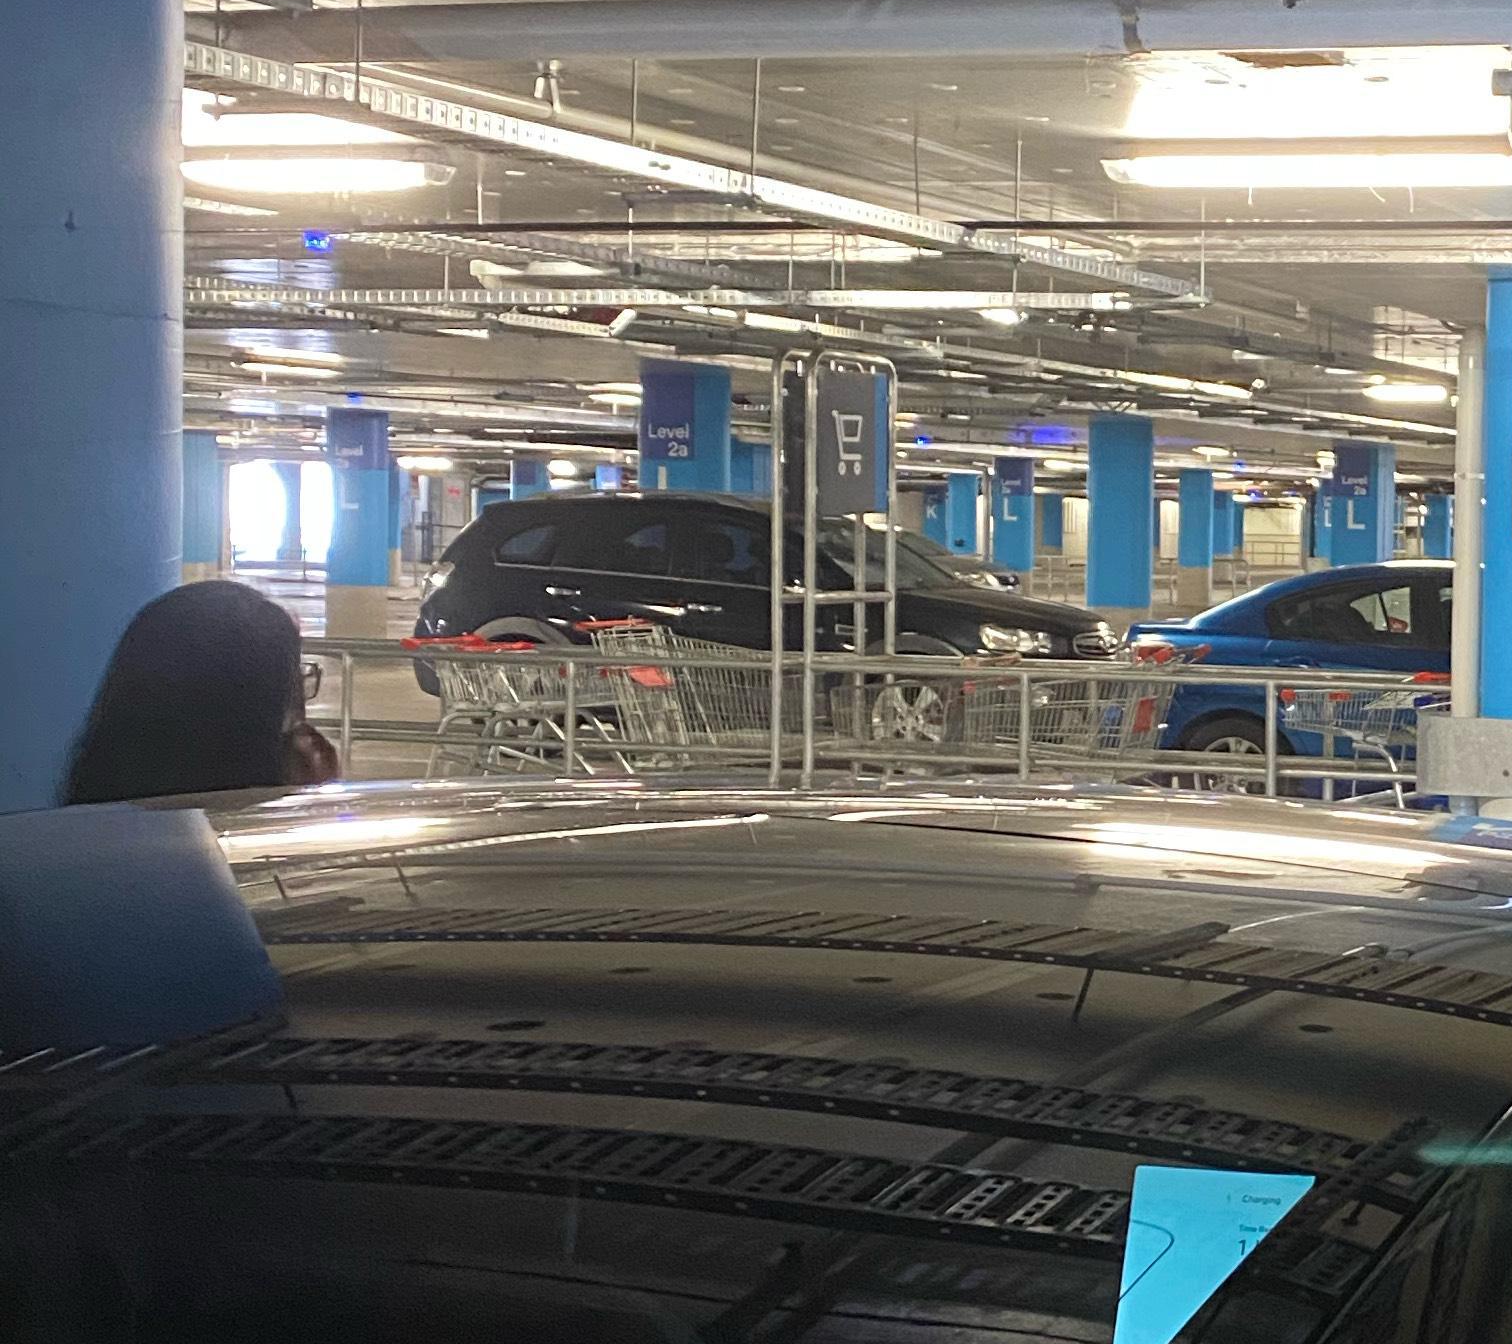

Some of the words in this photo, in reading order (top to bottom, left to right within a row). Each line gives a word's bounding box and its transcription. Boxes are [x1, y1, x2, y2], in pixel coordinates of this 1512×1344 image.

[648, 423, 690, 439] Level
[668, 441, 688, 457] 2a
[926, 504, 938, 519] K
[1003, 498, 1018, 521] L
[1347, 500, 1366, 530] L
[1241, 1194, 1282, 1206] Charging
